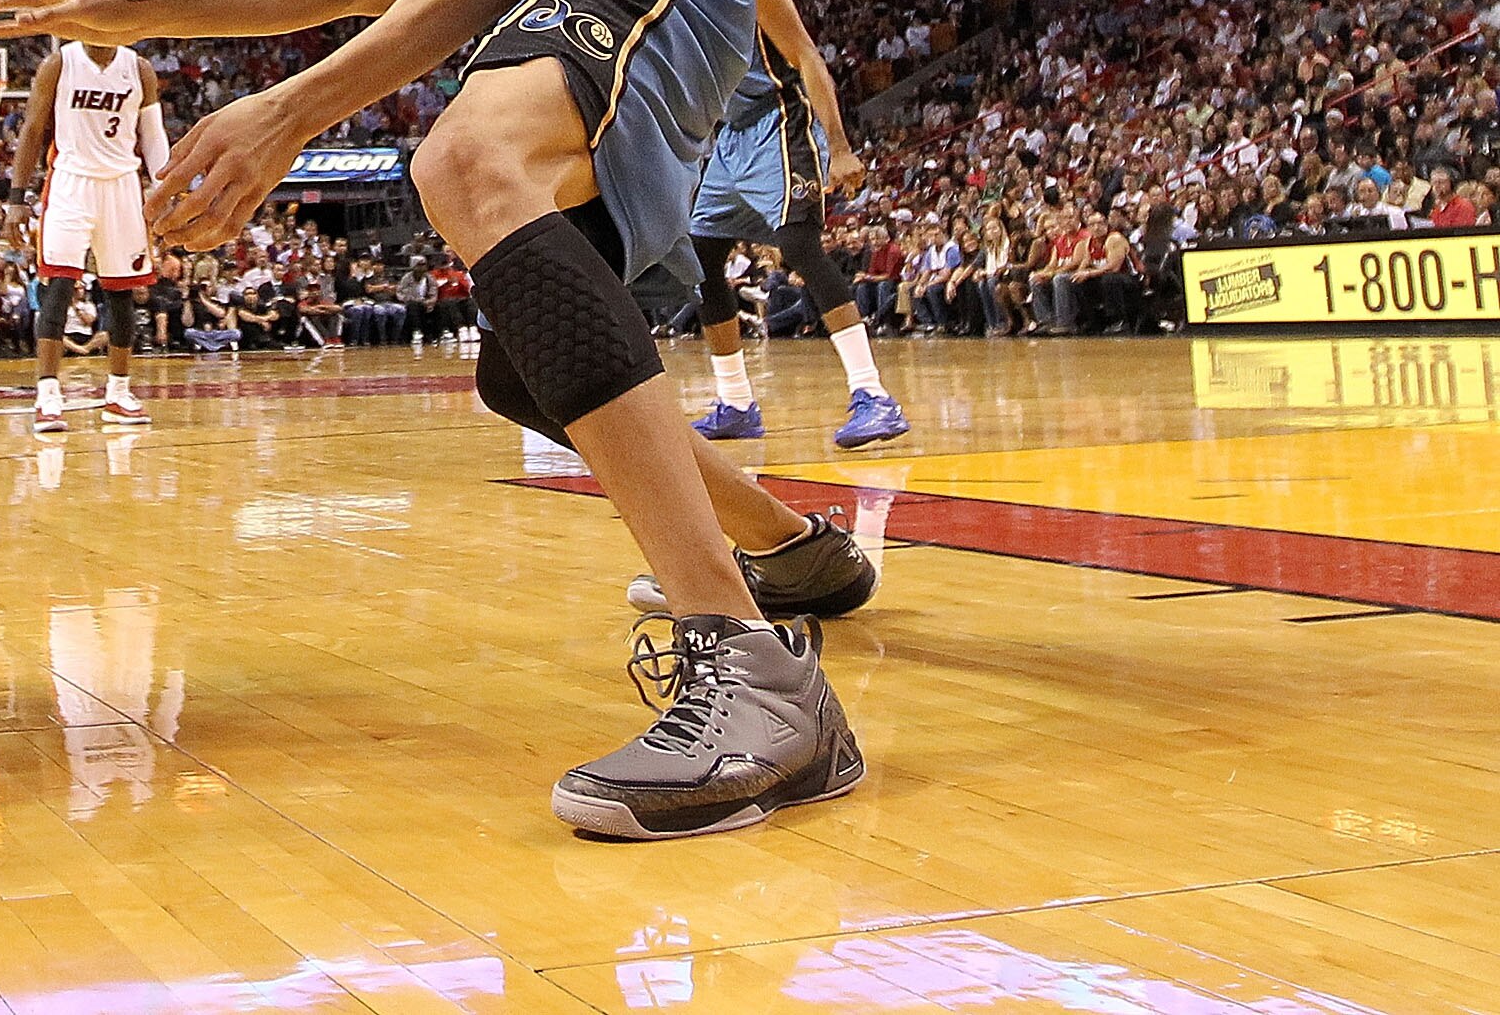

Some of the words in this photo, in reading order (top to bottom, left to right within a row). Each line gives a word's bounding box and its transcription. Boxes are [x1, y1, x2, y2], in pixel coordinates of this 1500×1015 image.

[71, 88, 133, 113] HEAT
[103, 115, 121, 139] 3
[305, 153, 399, 172] LIGHT
[1216, 268, 1261, 293] LUMBER
